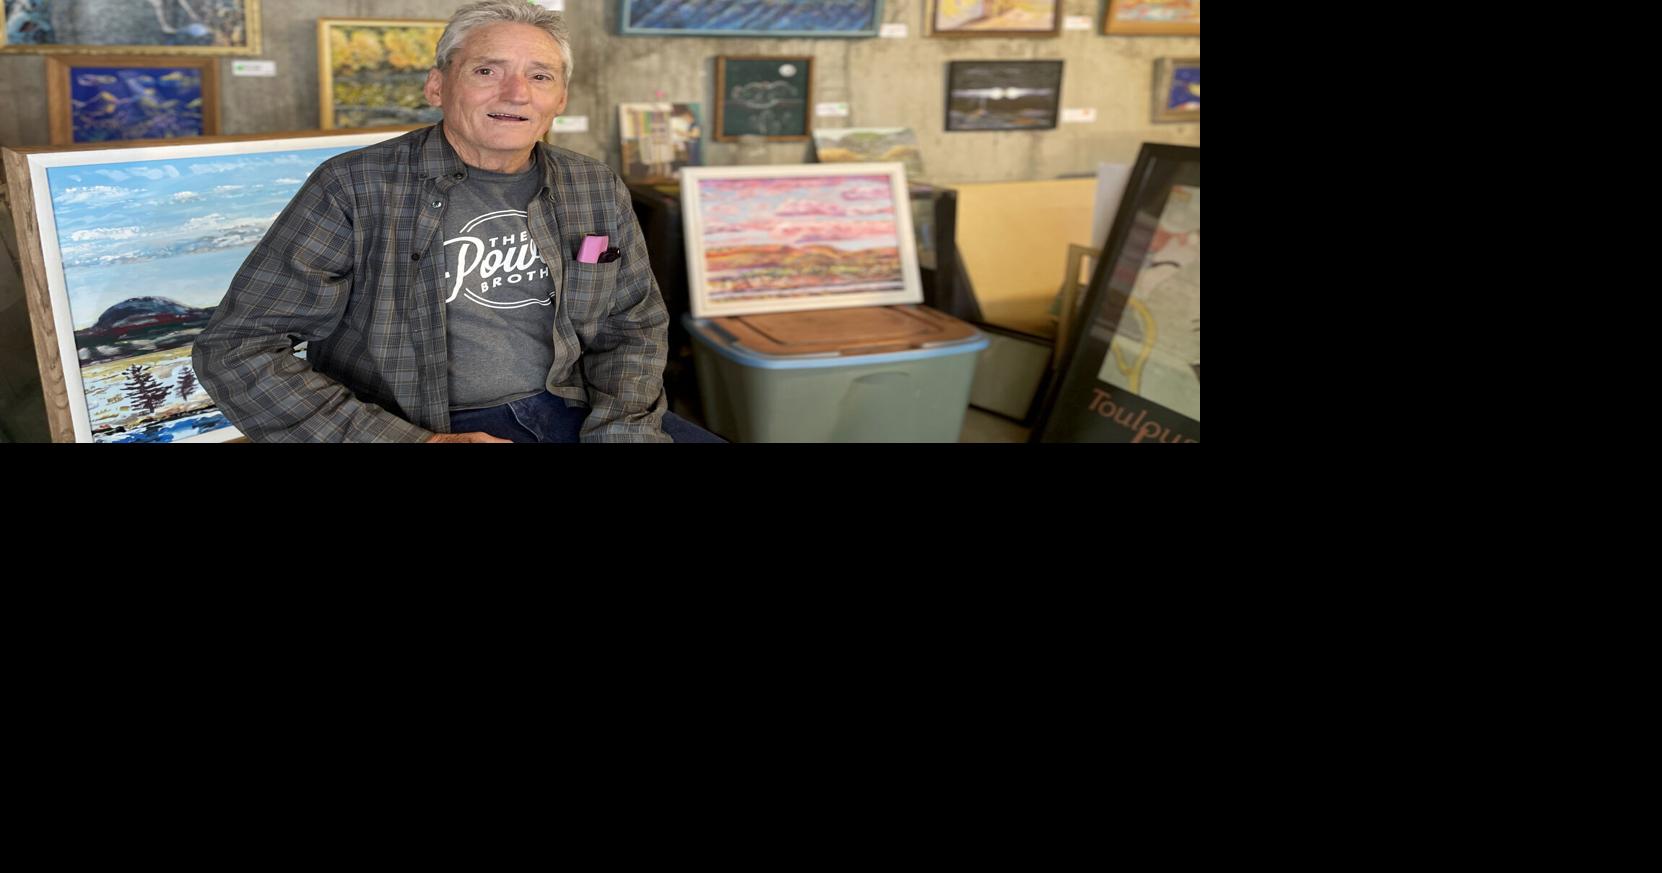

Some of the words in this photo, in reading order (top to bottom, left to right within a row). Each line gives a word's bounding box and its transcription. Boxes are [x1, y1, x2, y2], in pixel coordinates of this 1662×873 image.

[488, 230, 528, 248] THE
[443, 236, 547, 303] Pow
[480, 266, 549, 294] BROTH
